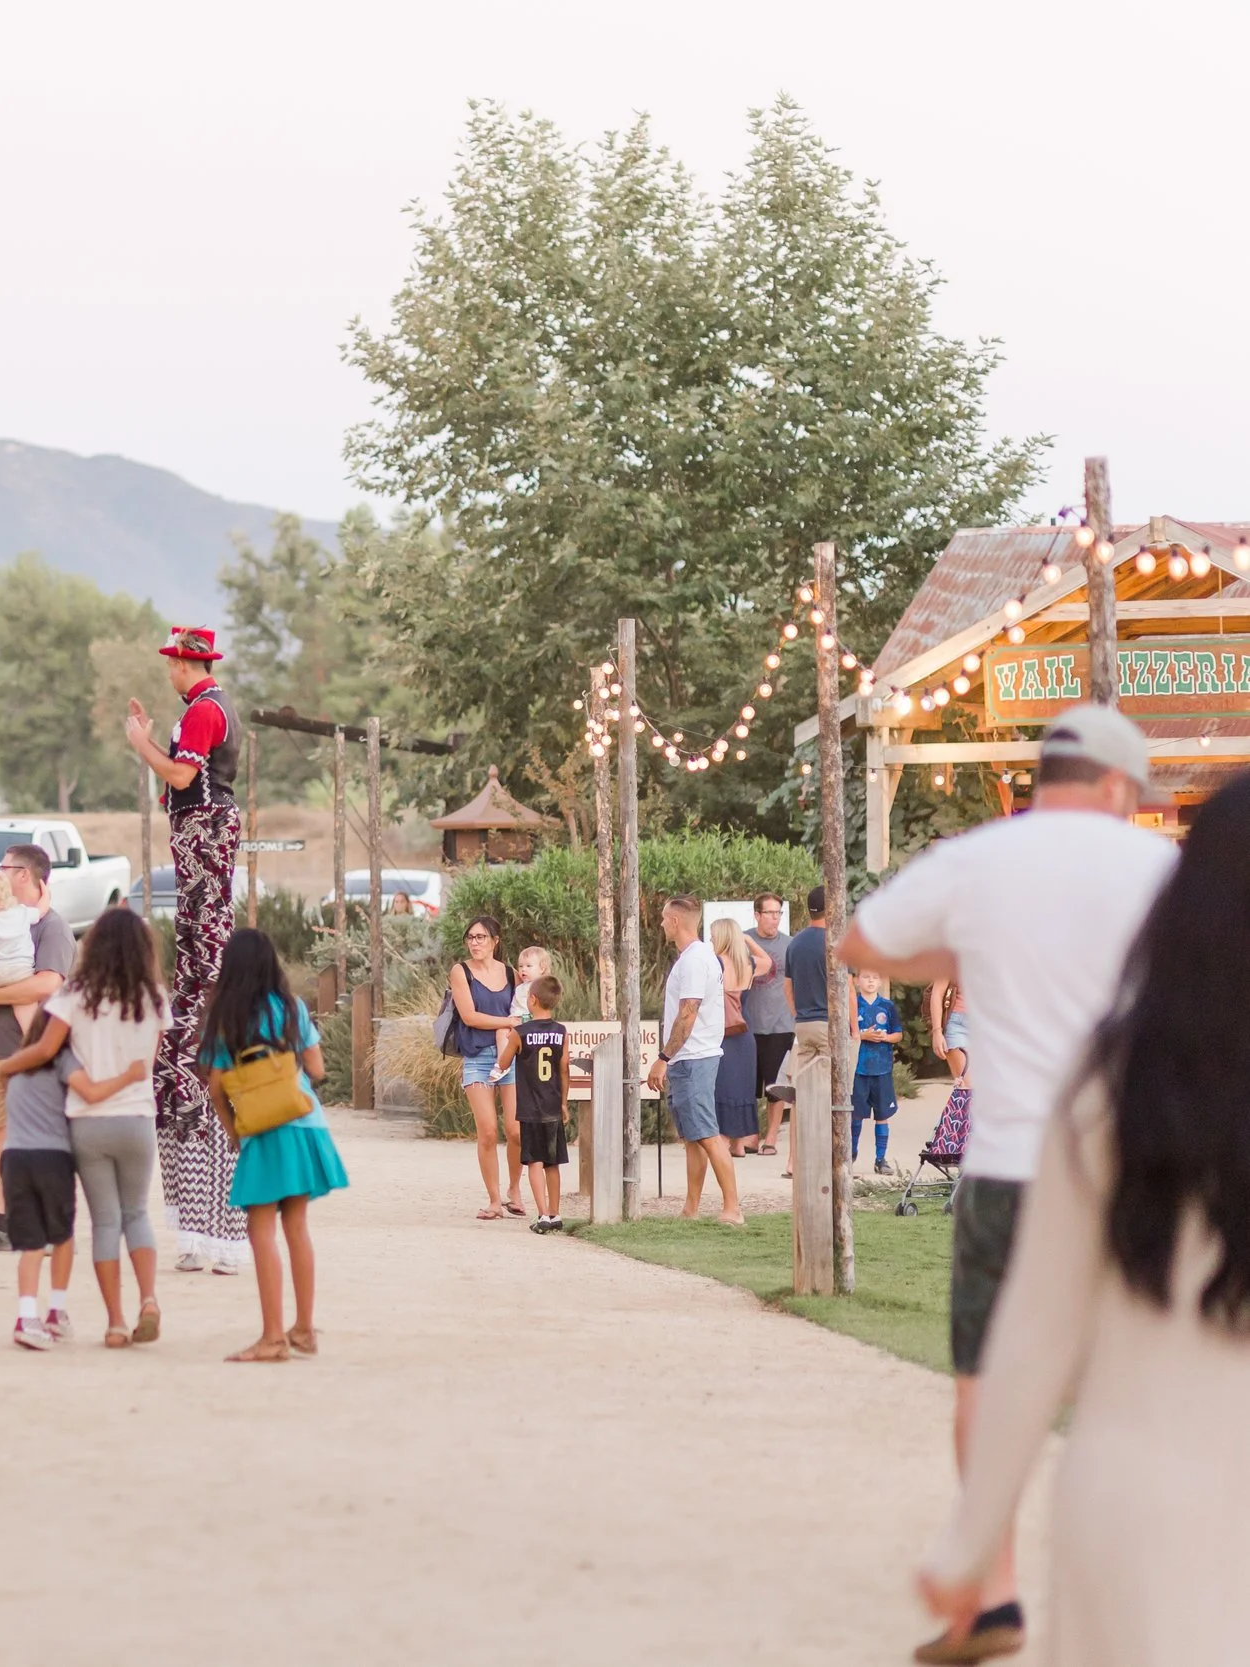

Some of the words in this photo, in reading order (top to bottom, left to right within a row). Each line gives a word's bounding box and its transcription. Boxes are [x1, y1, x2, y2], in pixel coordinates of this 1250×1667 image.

[995, 655, 1081, 700] VAIL
[1117, 651, 1250, 696] IZZERI
[526, 1032, 564, 1046] COMPTON
[567, 1030, 612, 1048] ntique
[538, 1046, 553, 1082] 6
